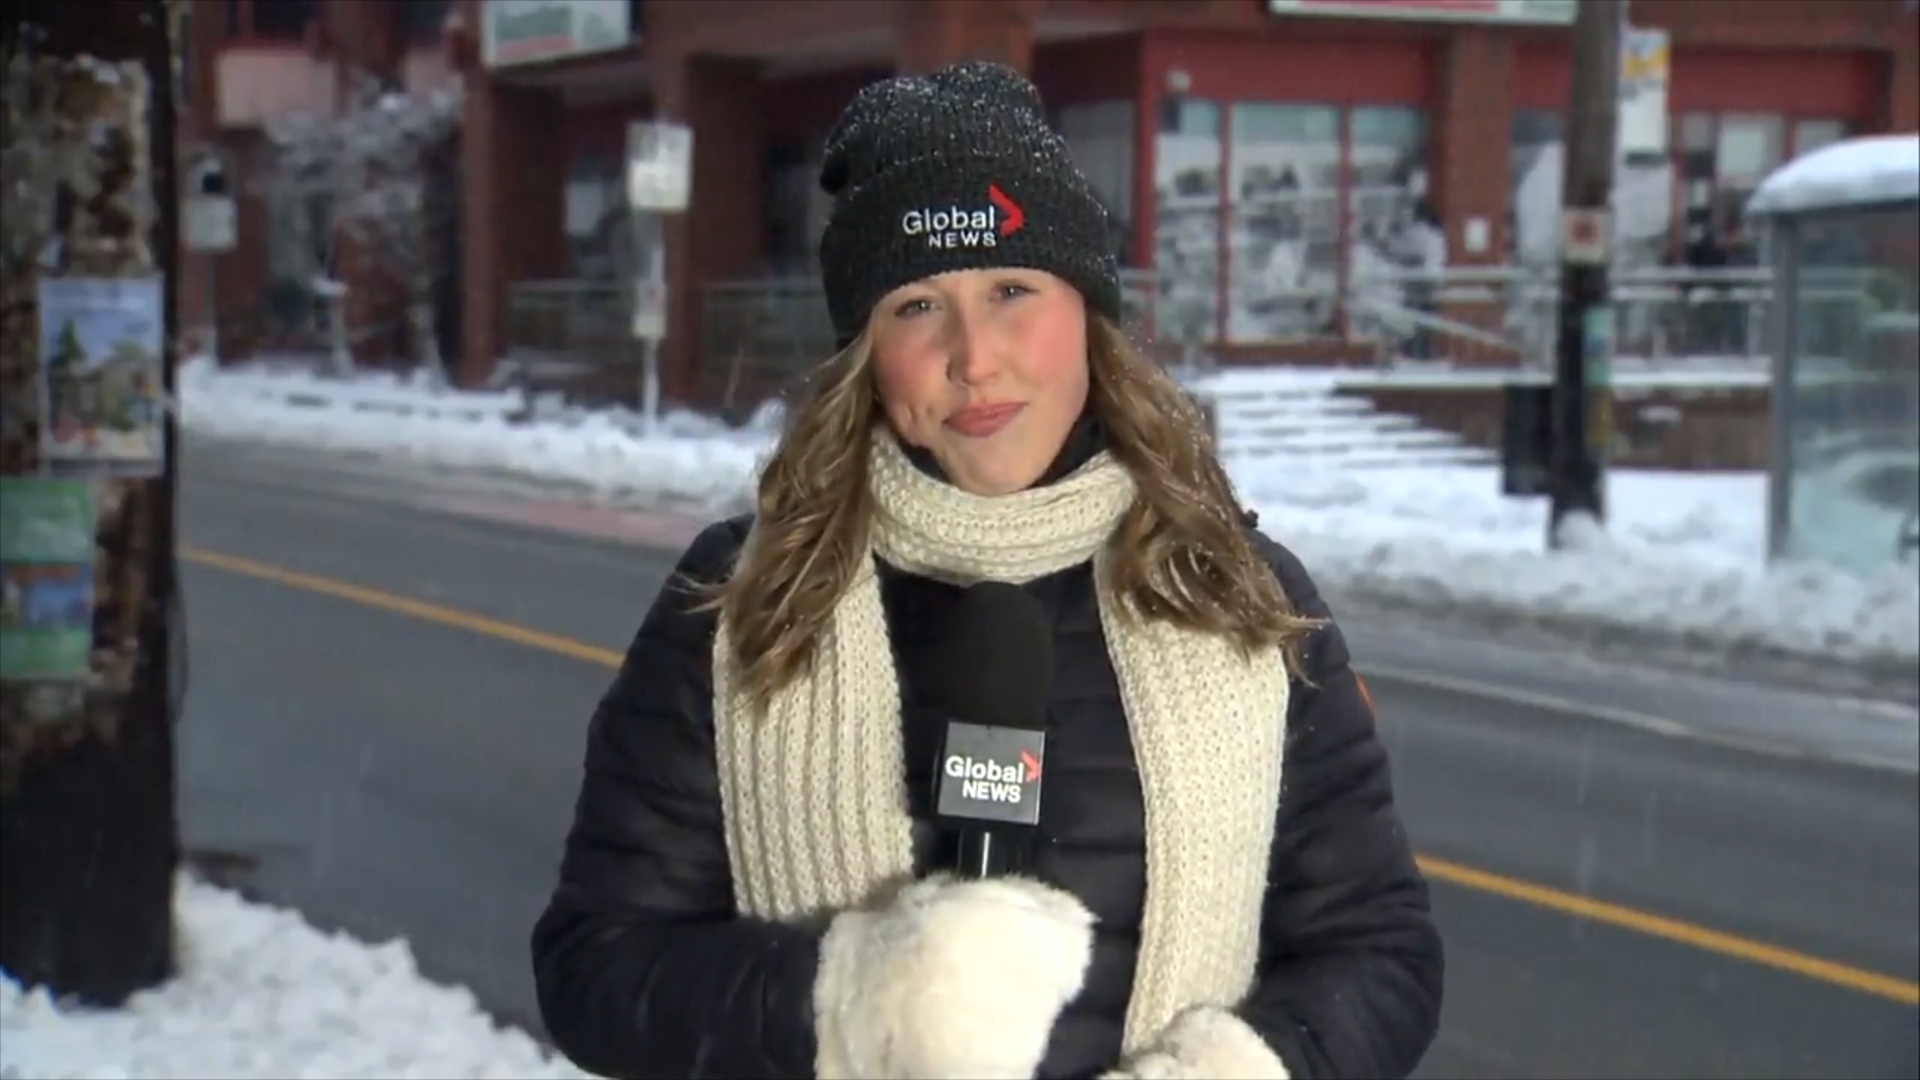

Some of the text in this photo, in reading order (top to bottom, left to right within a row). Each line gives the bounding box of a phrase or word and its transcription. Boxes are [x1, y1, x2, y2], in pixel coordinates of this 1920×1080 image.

[902, 204, 995, 235] Global
[928, 231, 997, 249] NEWS
[945, 755, 1024, 784] Global
[962, 779, 1021, 804] NEWS
